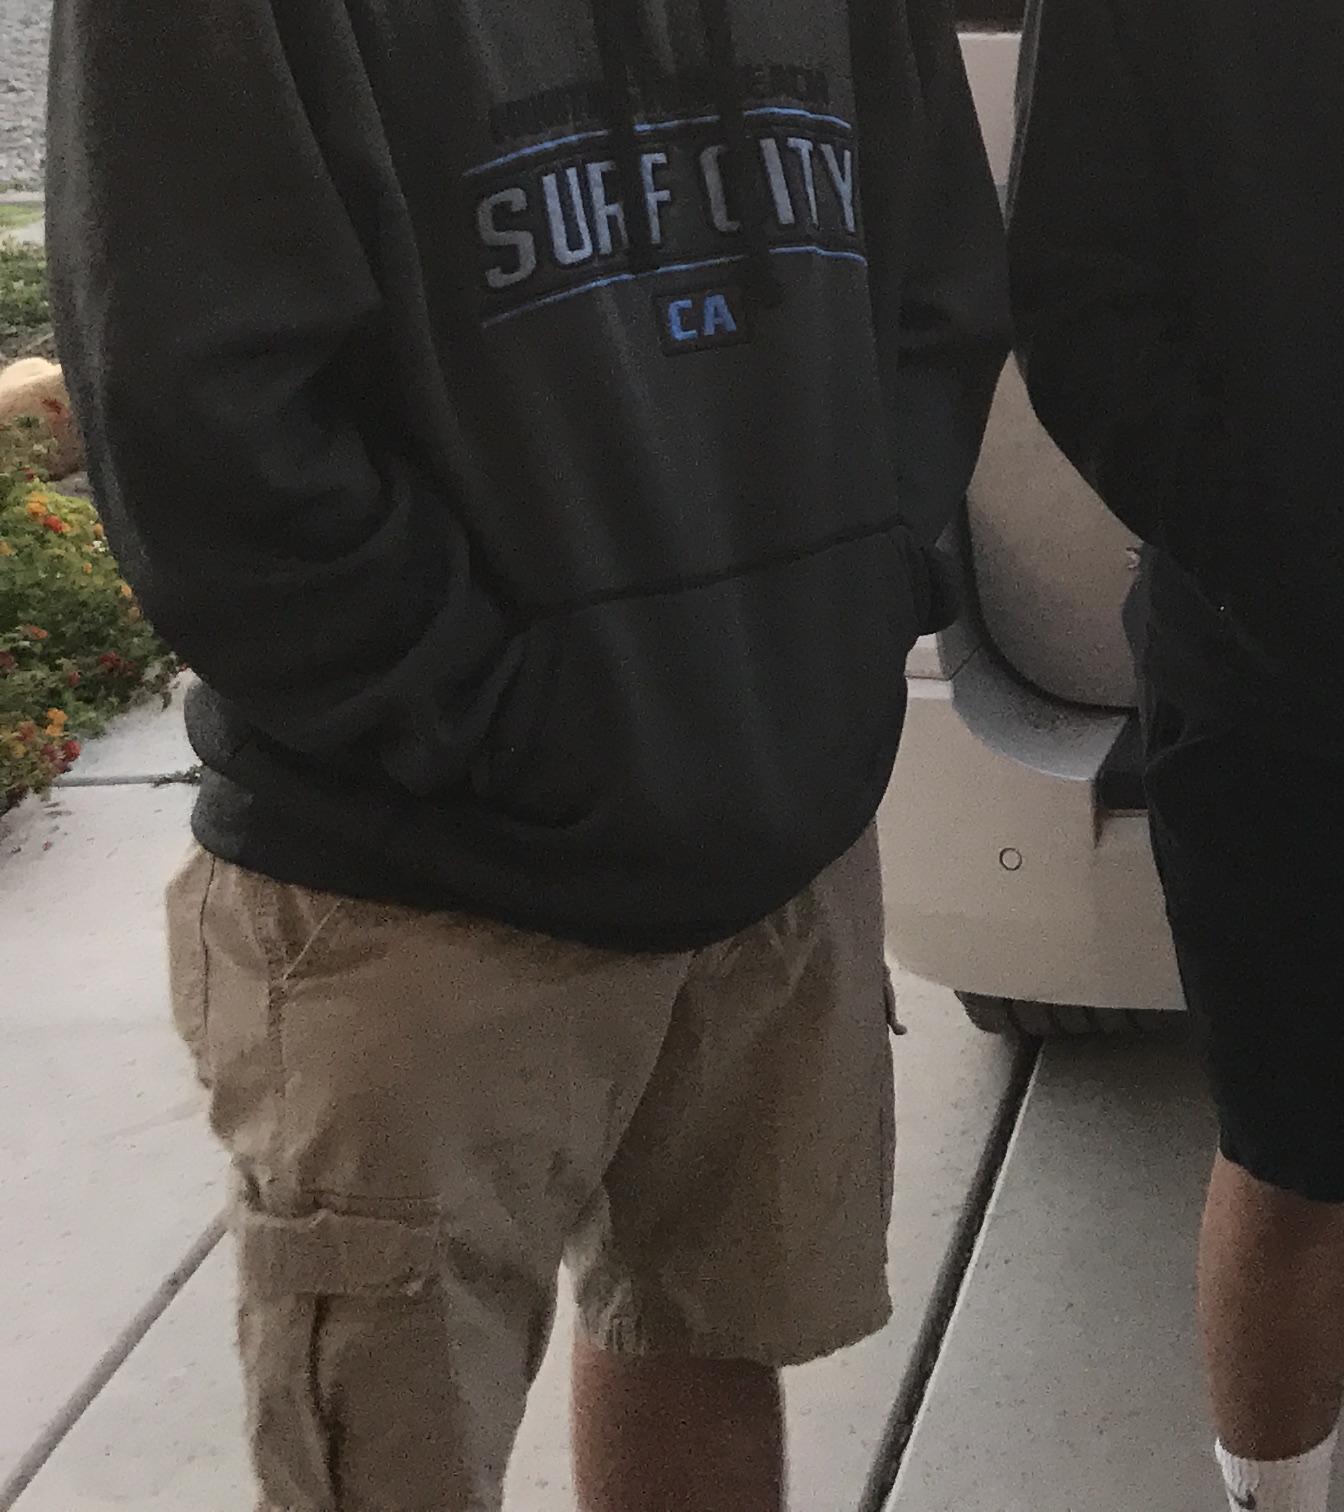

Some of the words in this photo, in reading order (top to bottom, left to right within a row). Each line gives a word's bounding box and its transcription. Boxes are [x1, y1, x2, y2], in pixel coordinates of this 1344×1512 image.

[475, 152, 672, 288] SURF
[700, 136, 857, 233] CITY
[666, 294, 737, 342] CA
